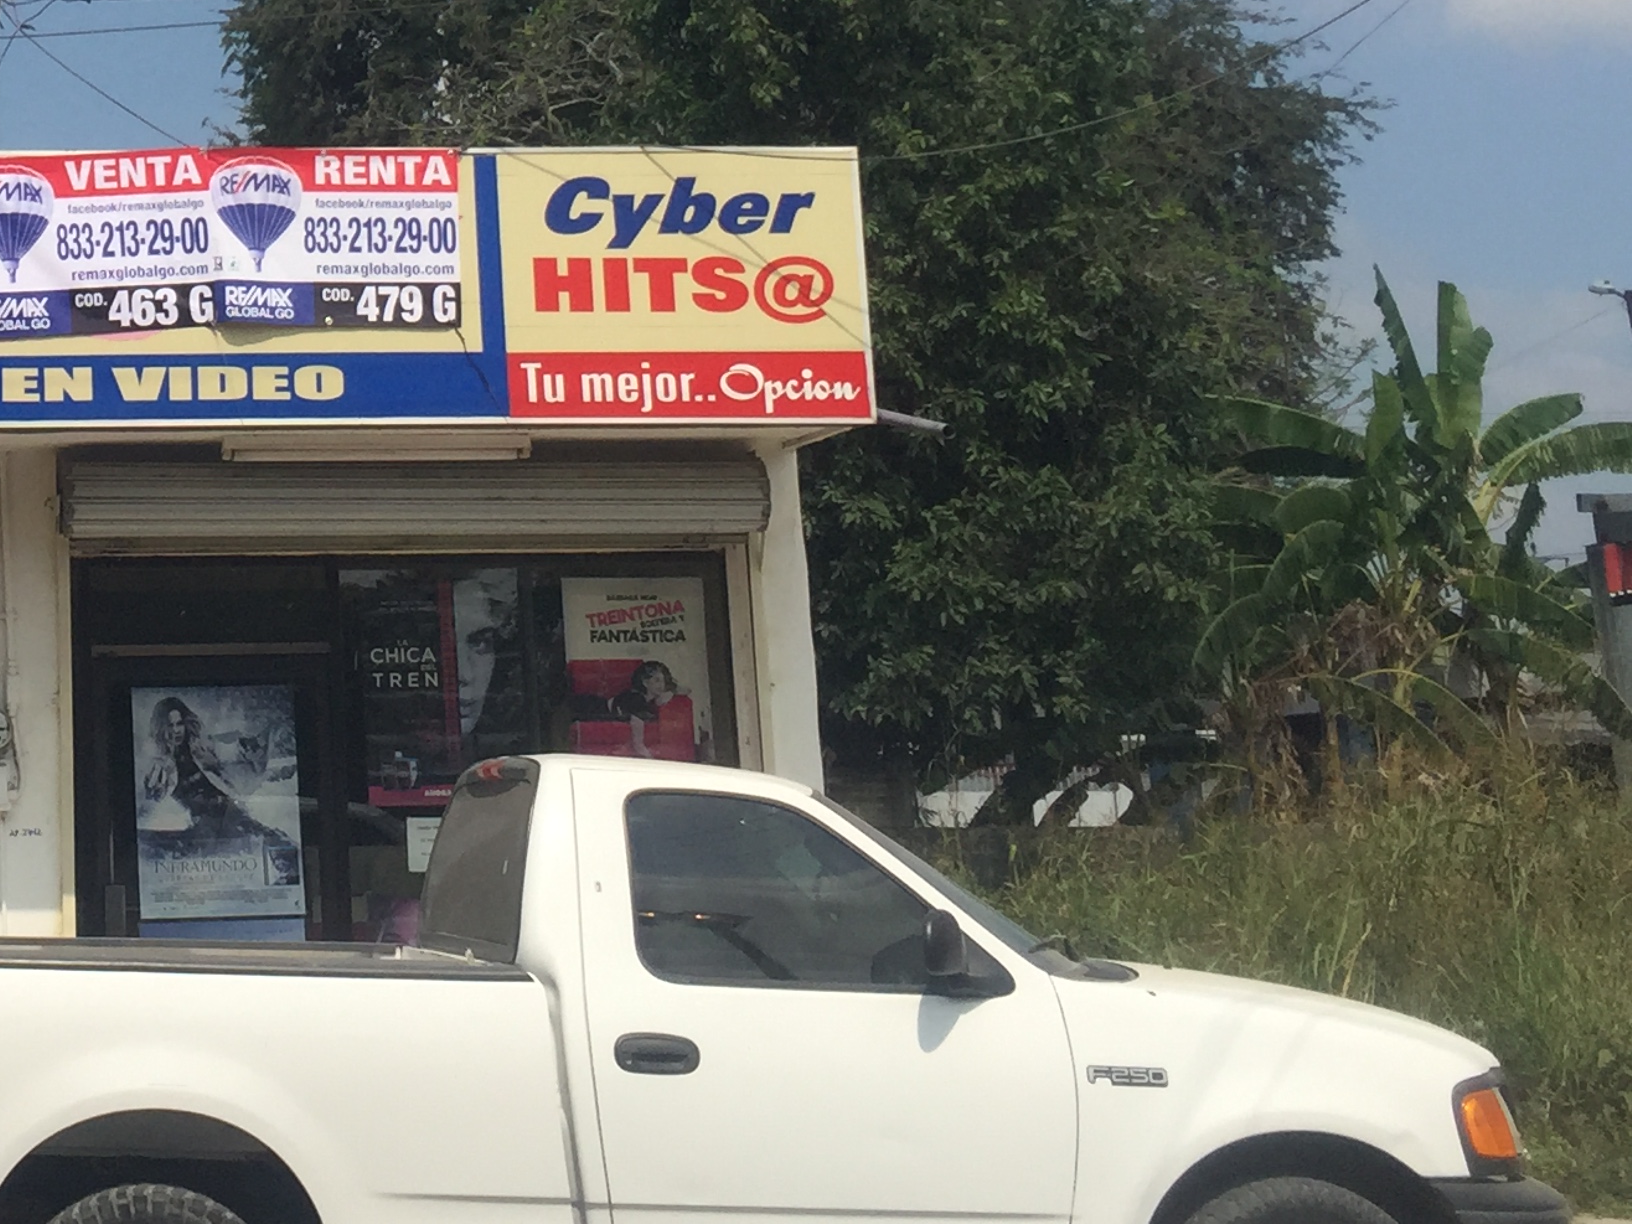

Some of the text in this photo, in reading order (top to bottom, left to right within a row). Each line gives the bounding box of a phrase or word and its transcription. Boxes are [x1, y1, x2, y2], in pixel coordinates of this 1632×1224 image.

[64, 154, 204, 192] VENTA
[220, 171, 292, 197] RE/MAX
[314, 154, 453, 186] RENTA
[544, 176, 816, 250] Cyber
[56, 216, 210, 262] 833-213-29-00
[304, 216, 457, 255] 833-213-29-00
[71, 264, 210, 283] remaxglobalgo.com
[316, 262, 455, 278] remaxglobalgo.com
[224, 284, 294, 308] RE/MAX
[322, 284, 458, 324] COD. 479 G
[532, 255, 835, 325] HITS@
[74, 284, 214, 328] COD. 463 G
[225, 306, 295, 320] GLOBAL GO
[31, 318, 51, 331] GO
[1, 365, 104, 403] EN
[111, 363, 346, 402] VIDEO
[520, 362, 565, 404] Tu
[719, 363, 861, 415] Opcion
[585, 599, 685, 628] TREINTONA
[589, 626, 687, 643] FANTÁSTICA
[370, 646, 437, 664] CHICA
[371, 671, 439, 688] TREN
[154, 857, 258, 874] INFRAMUNDO
